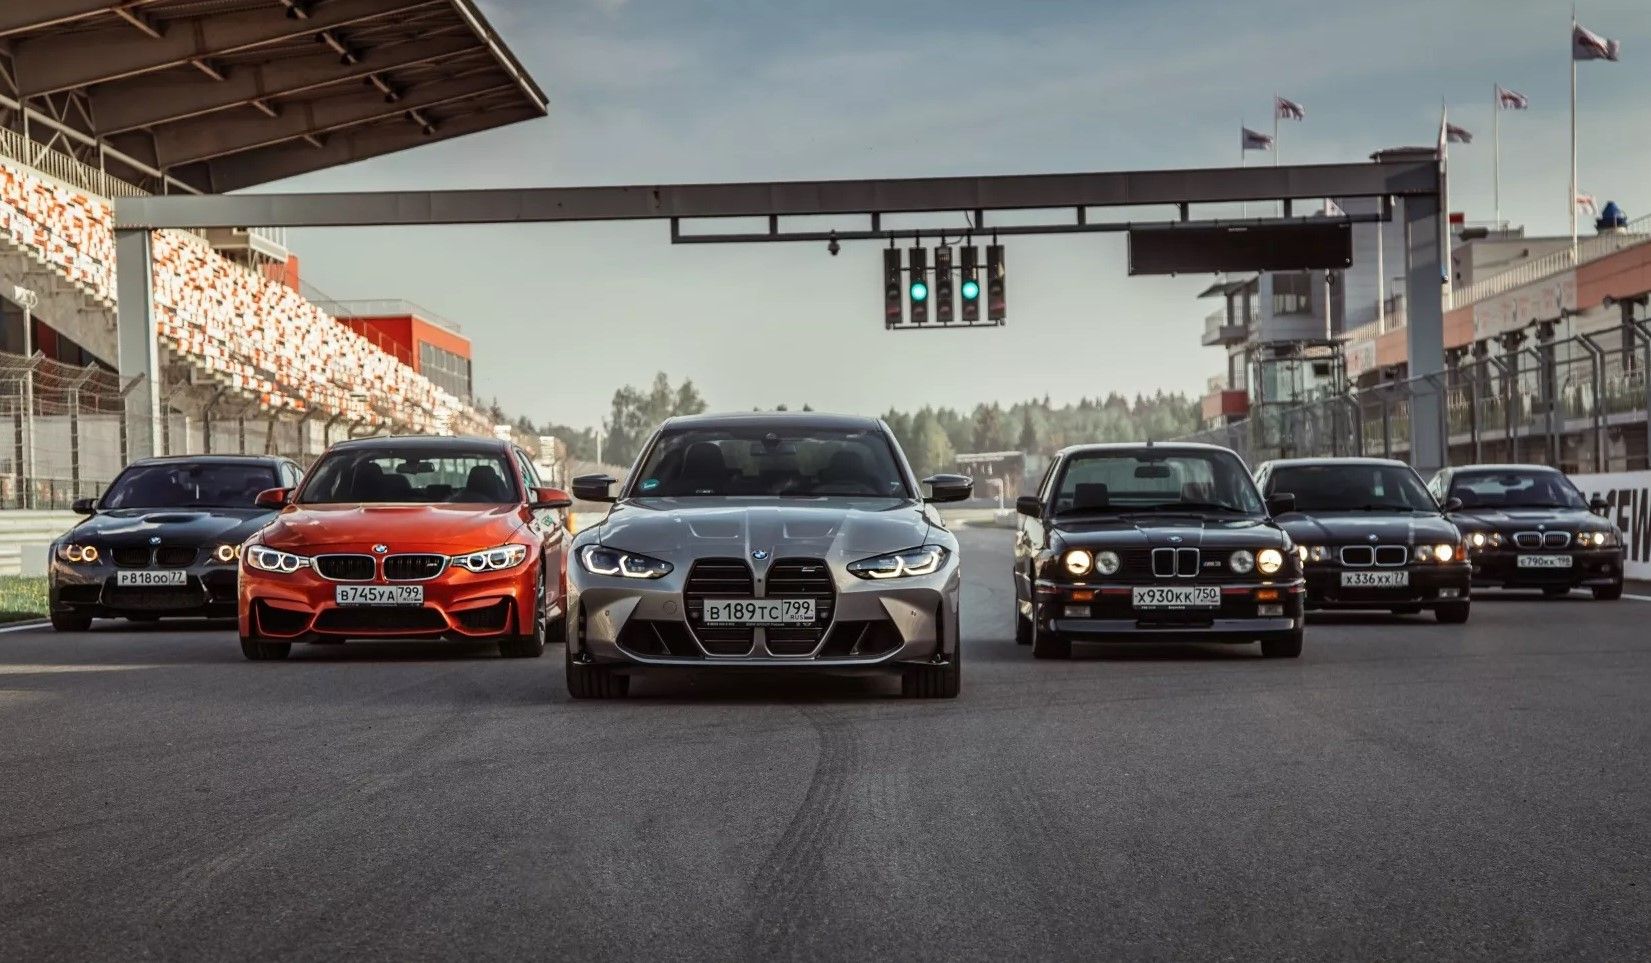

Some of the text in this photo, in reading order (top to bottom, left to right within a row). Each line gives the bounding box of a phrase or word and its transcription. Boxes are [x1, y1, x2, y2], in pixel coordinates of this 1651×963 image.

[170, 571, 183, 580] 77
[398, 586, 419, 598] 799
[1195, 588, 1217, 599] 750
[710, 601, 811, 620] В189ТС 799
